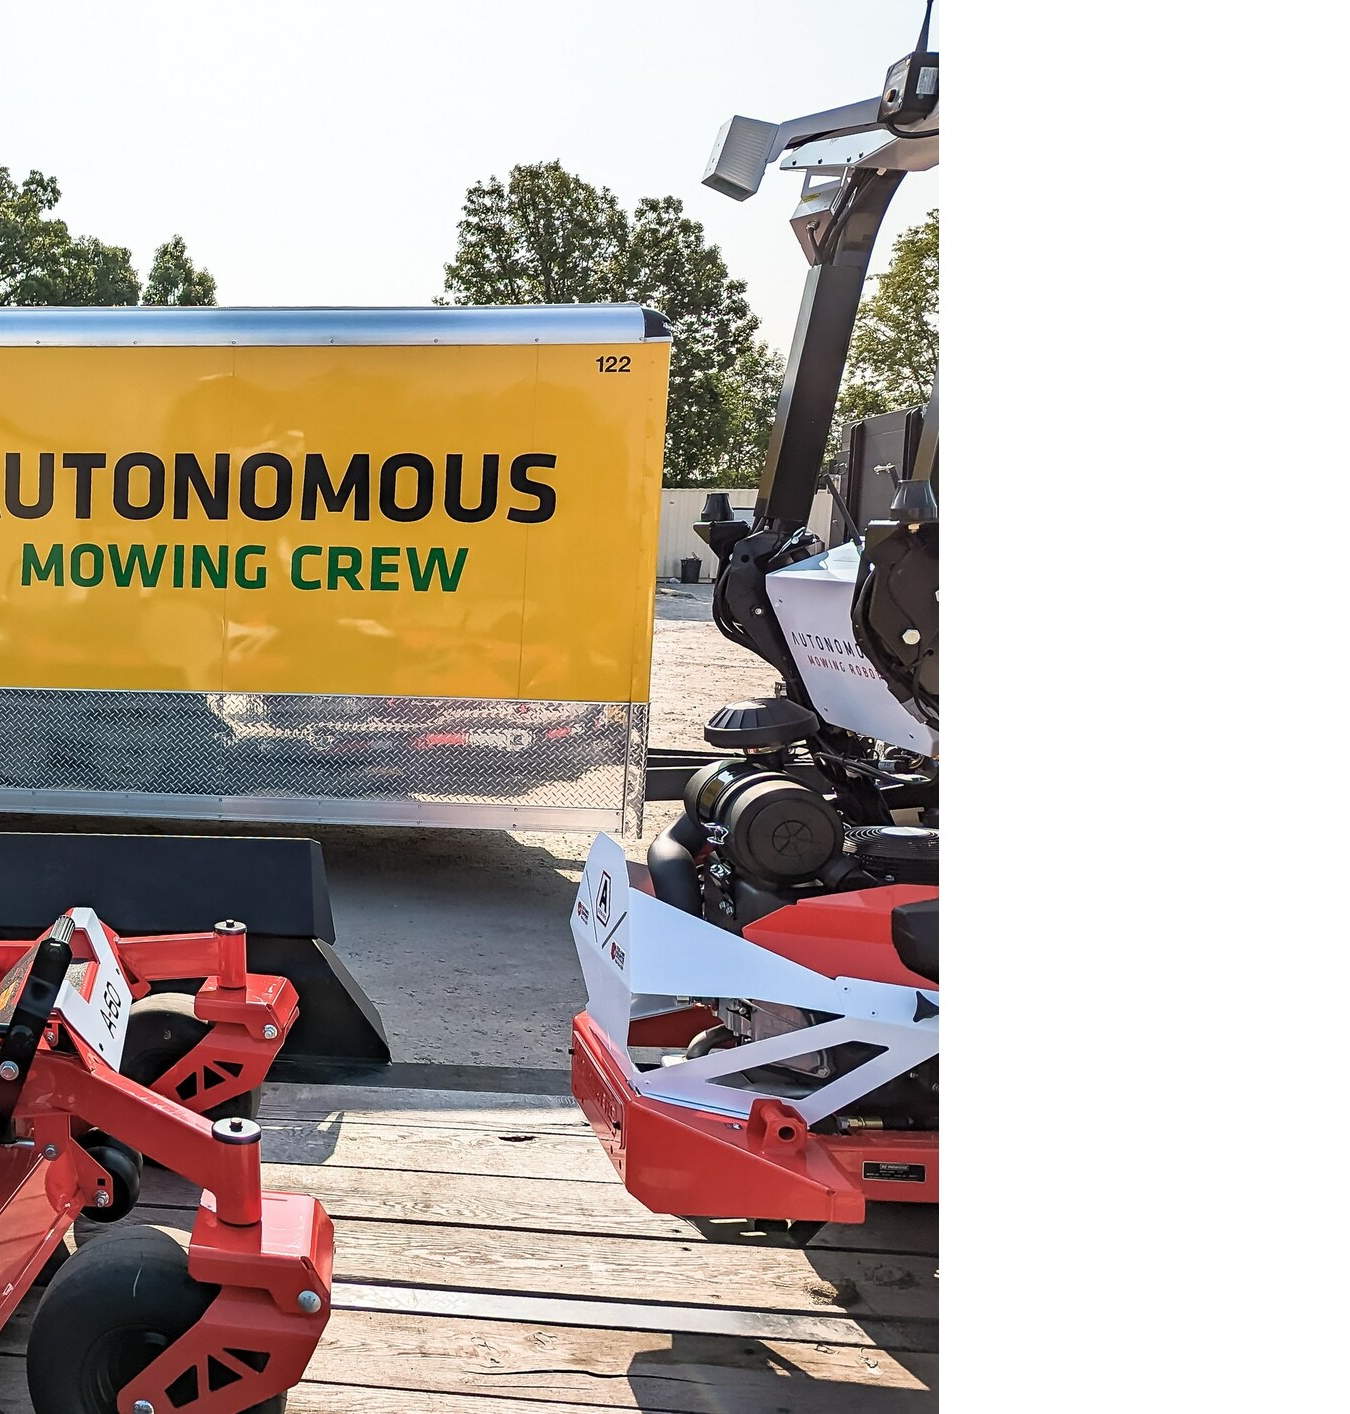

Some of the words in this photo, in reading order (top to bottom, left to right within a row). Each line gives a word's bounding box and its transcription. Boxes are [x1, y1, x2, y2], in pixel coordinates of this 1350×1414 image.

[596, 356, 631, 373] 122
[21, 543, 266, 589] MOWING
[290, 545, 469, 592] CREW
[791, 631, 864, 659] AUTONOMO
[807, 654, 845, 672] MOWING
[100, 981, 121, 1039] A-60
